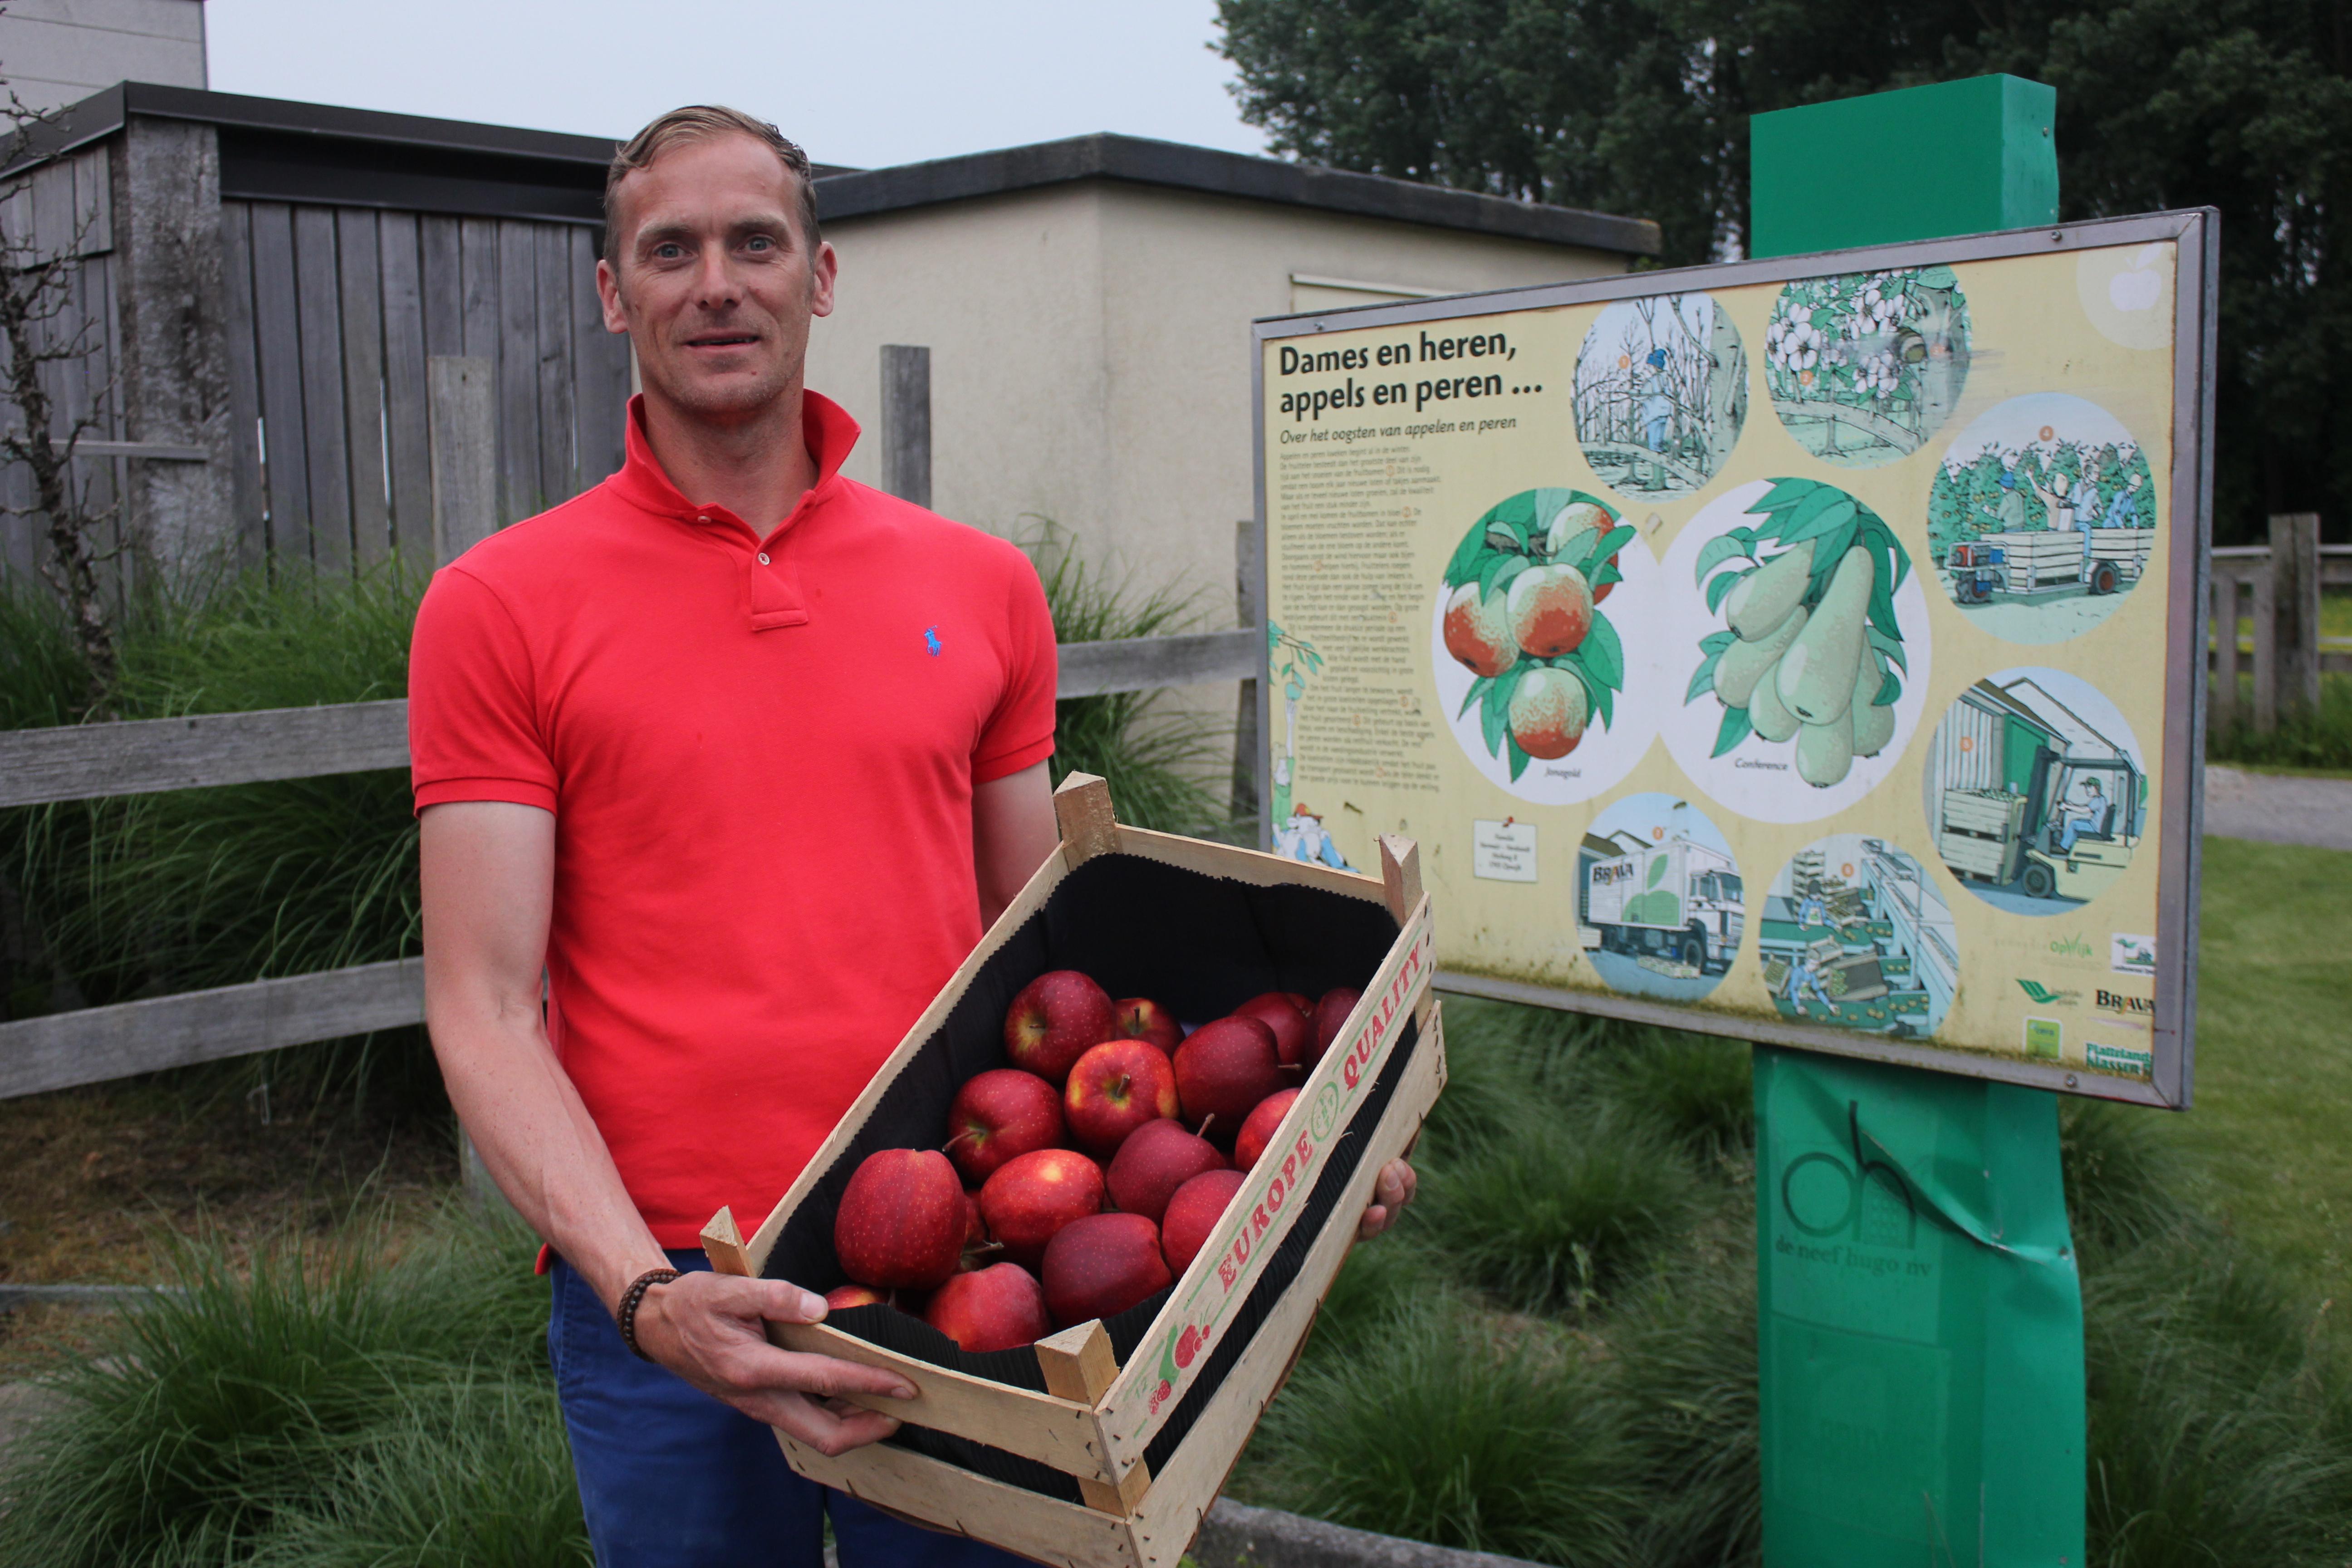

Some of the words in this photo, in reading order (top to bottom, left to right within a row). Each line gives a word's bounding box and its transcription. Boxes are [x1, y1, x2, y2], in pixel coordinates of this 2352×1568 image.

[1280, 345, 1368, 375] Dames
[1376, 342, 1411, 366] en
[1420, 331, 1516, 362] heren,
[1280, 378, 1365, 421] appels
[1372, 383, 1406, 406] en
[1415, 373, 1502, 412] peren
[1280, 430, 1307, 444] Over
[1310, 428, 1329, 443] het
[1332, 425, 1376, 444] oogsten
[1380, 426, 1401, 438] van
[1405, 419, 1455, 439] appelen
[1459, 421, 1475, 431] en
[1478, 417, 1516, 435] peren
[1735, 757, 1788, 771] Conference
[1218, 1130, 1313, 1294] EUROPE
[1344, 941, 1420, 1092] QUALITY
